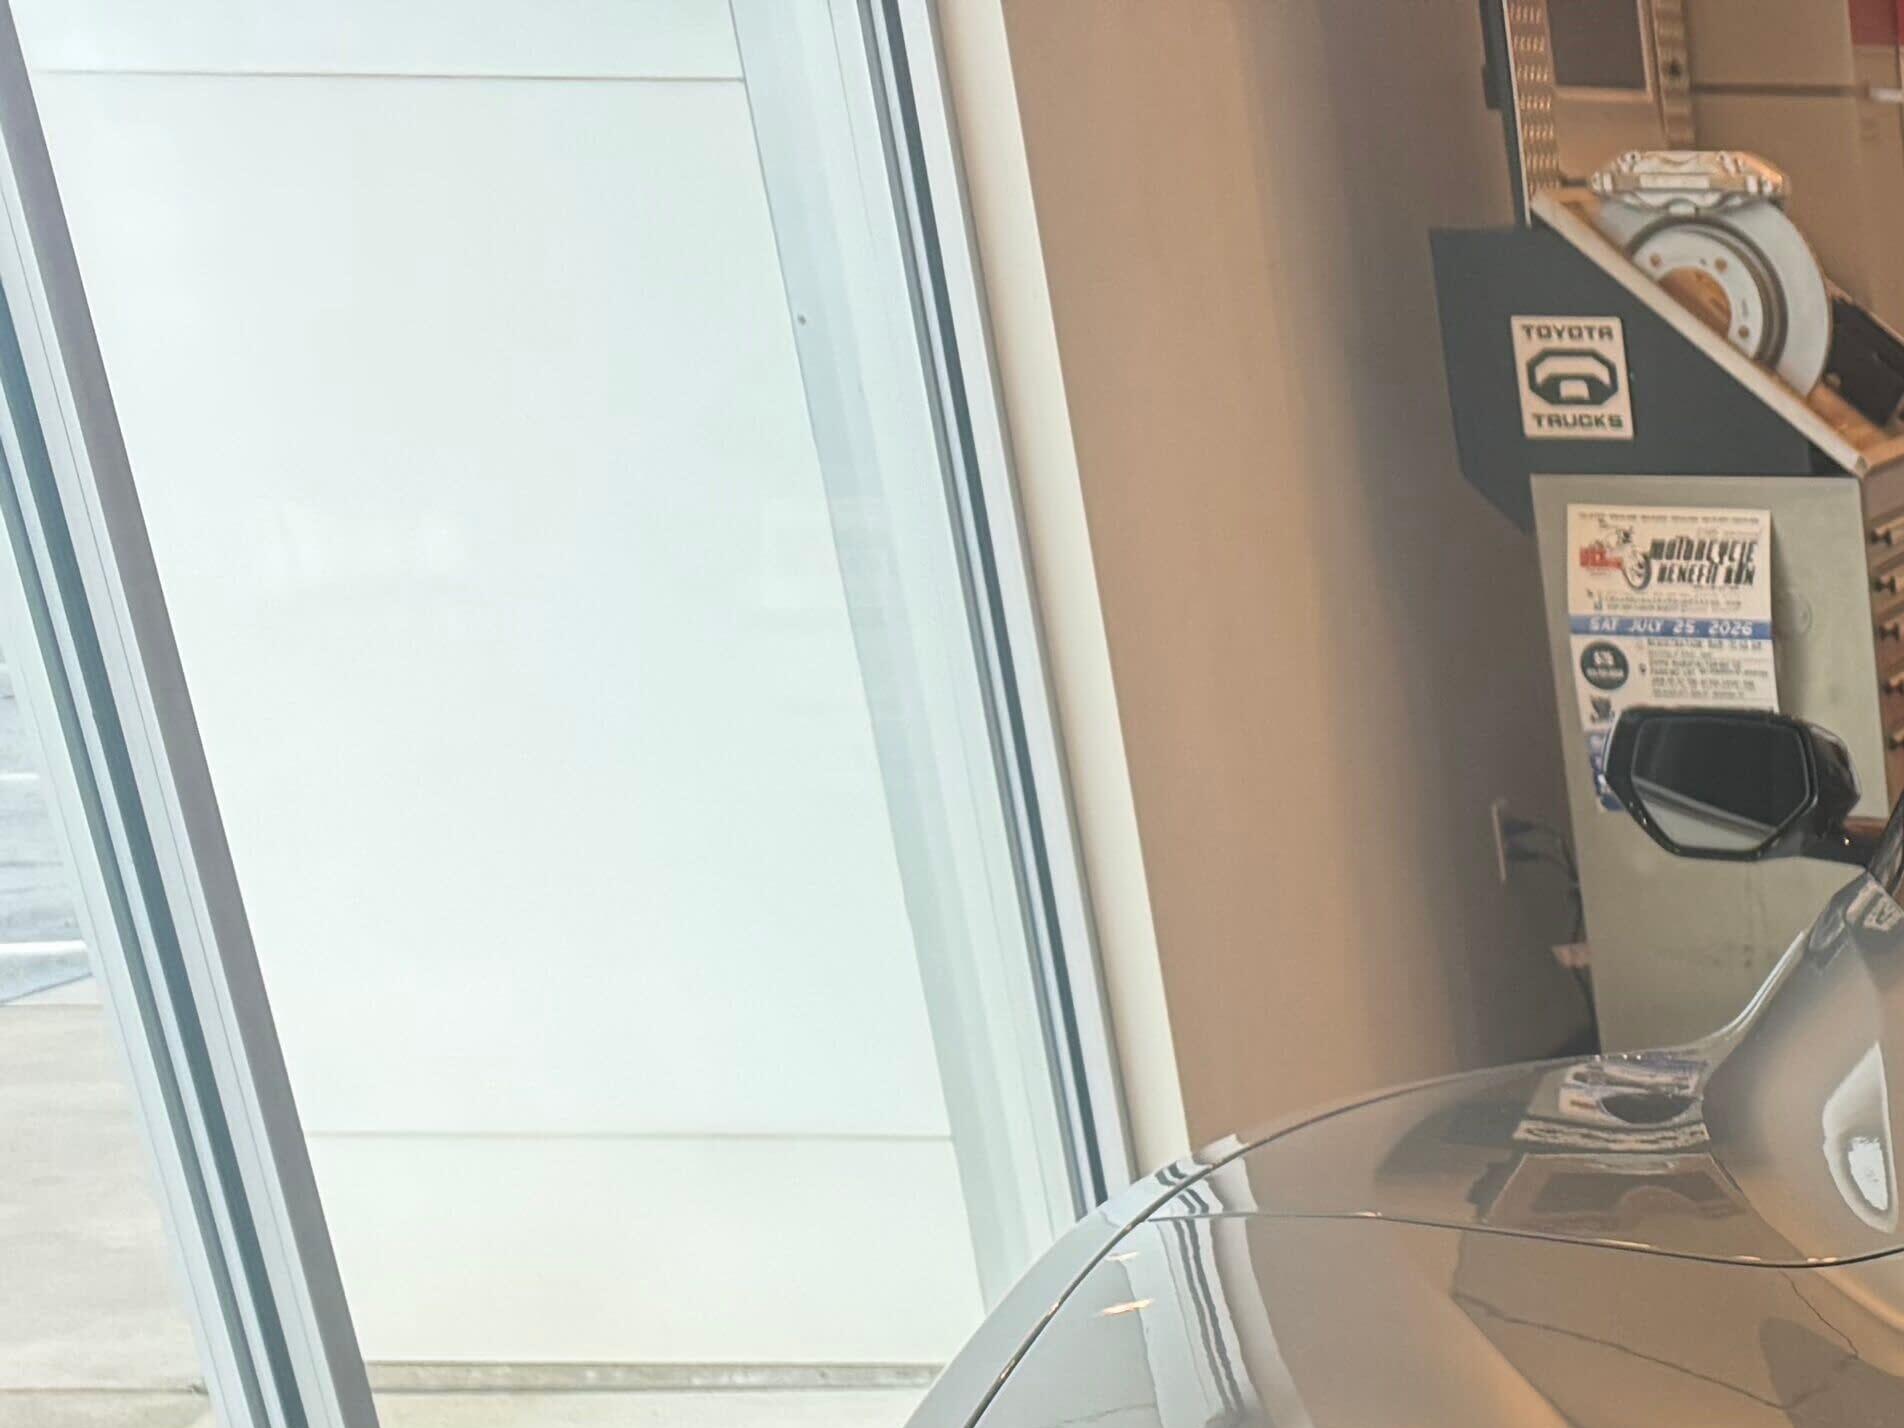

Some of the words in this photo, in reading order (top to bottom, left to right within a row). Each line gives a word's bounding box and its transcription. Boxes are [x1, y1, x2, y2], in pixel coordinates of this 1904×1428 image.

[1521, 323, 1614, 340] TOYOTA
[1532, 412, 1623, 429] TRUCKS
[1650, 536, 1758, 564] MOTORCYCLE
[1657, 562, 1719, 584] BENEFIT
[1589, 616, 1620, 632] SAT
[1629, 618, 1665, 634] JULY
[1708, 620, 1753, 637] 2026
